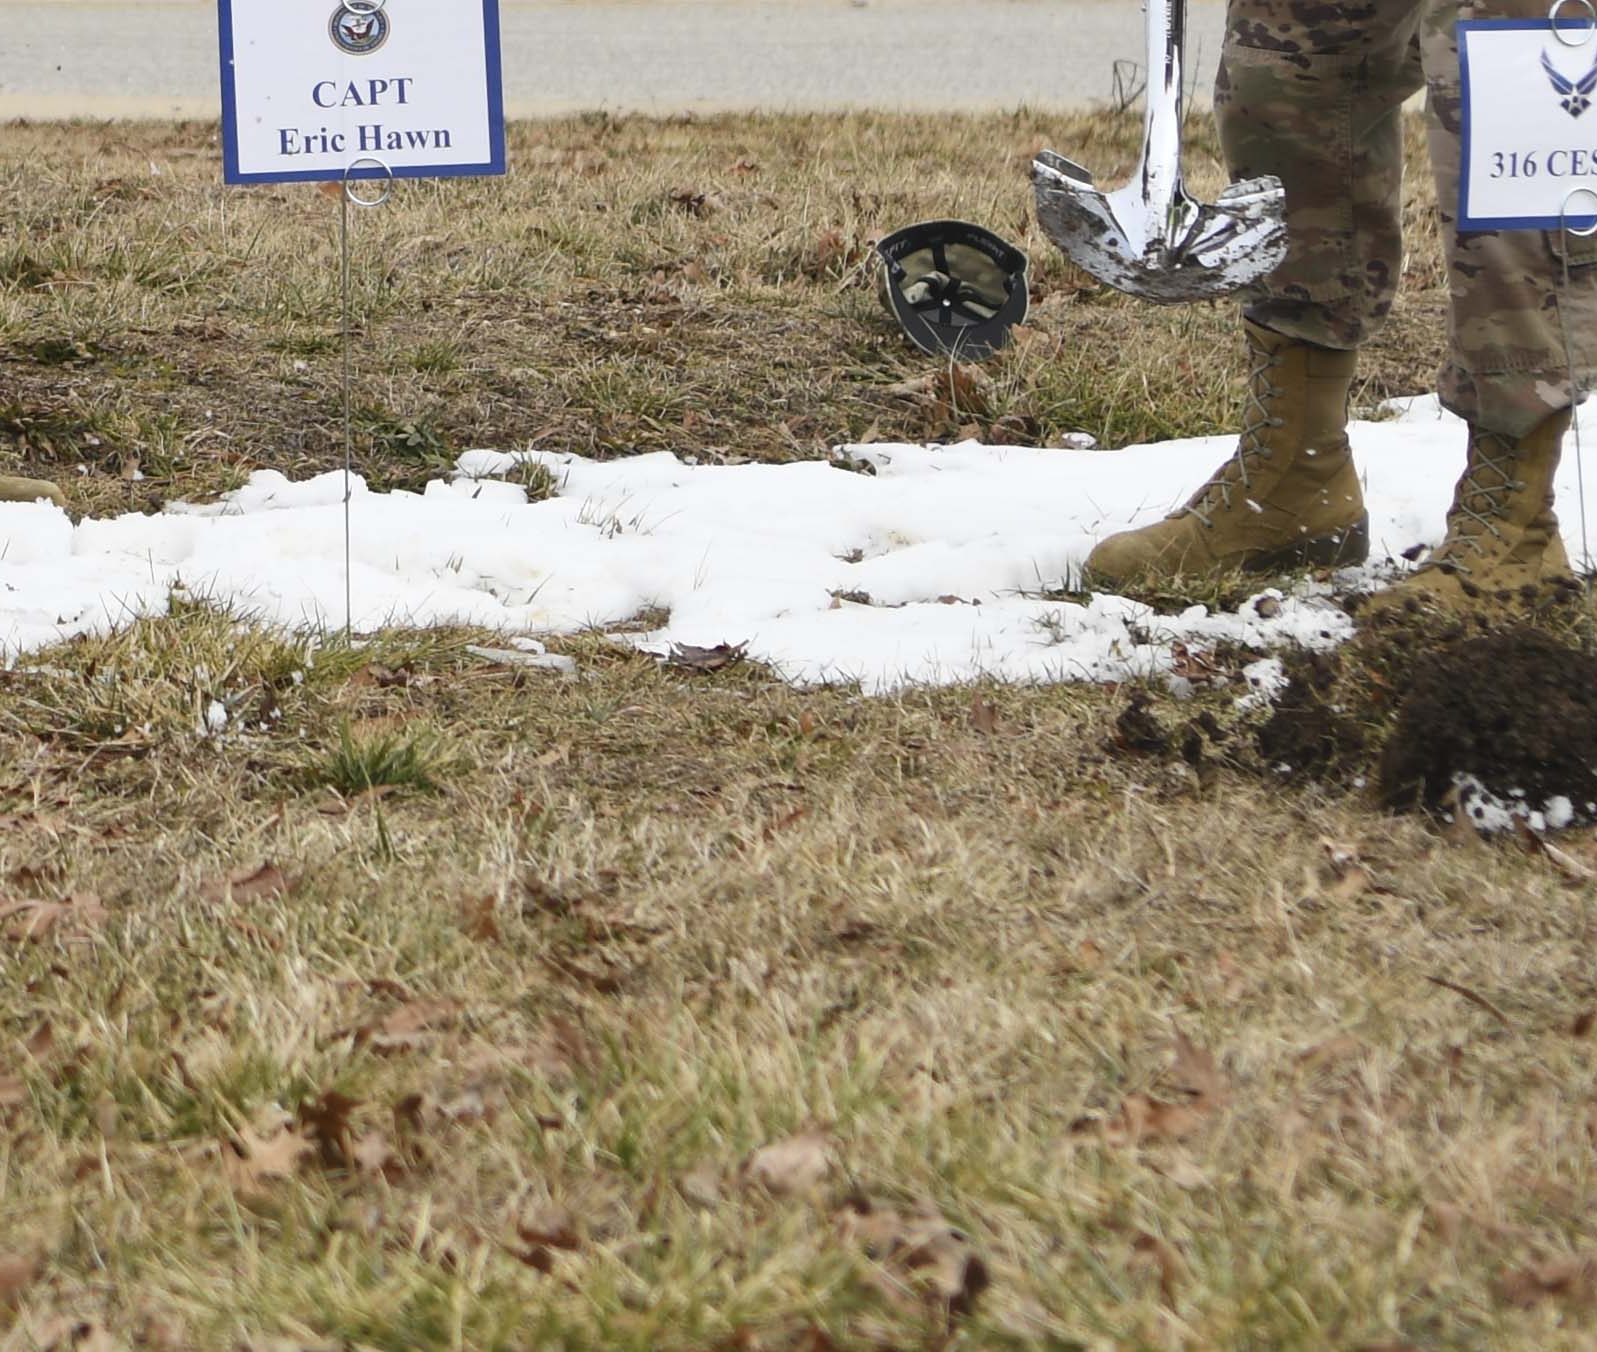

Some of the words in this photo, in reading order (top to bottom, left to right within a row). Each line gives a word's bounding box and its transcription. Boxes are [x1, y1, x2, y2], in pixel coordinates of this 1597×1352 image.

[311, 77, 414, 109] CAPT
[278, 126, 347, 156] Eric
[355, 123, 453, 153] Hawn
[1489, 150, 1538, 179] 316
